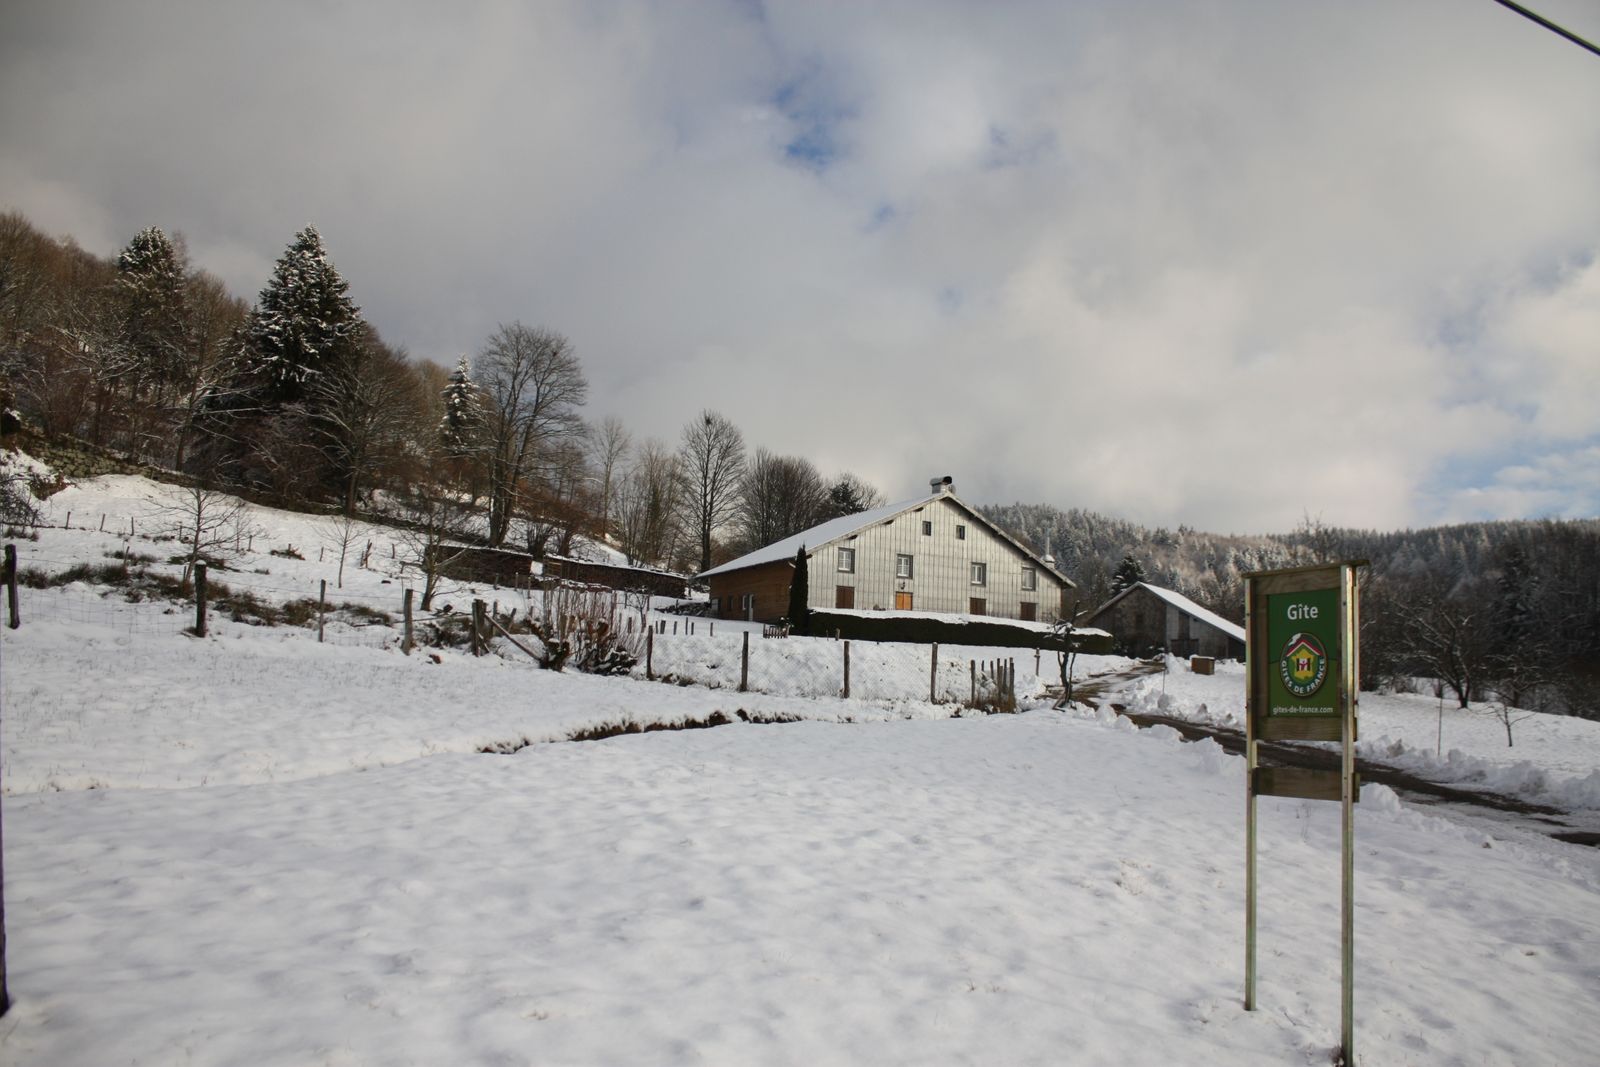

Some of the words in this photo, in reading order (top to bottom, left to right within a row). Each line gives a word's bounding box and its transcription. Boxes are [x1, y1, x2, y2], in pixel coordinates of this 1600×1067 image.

[1287, 604, 1319, 620] Gîte
[1294, 685, 1304, 694] DE
[1306, 658, 1325, 693] FRANCE
[1272, 705, 1334, 715] gites-de-france.com
